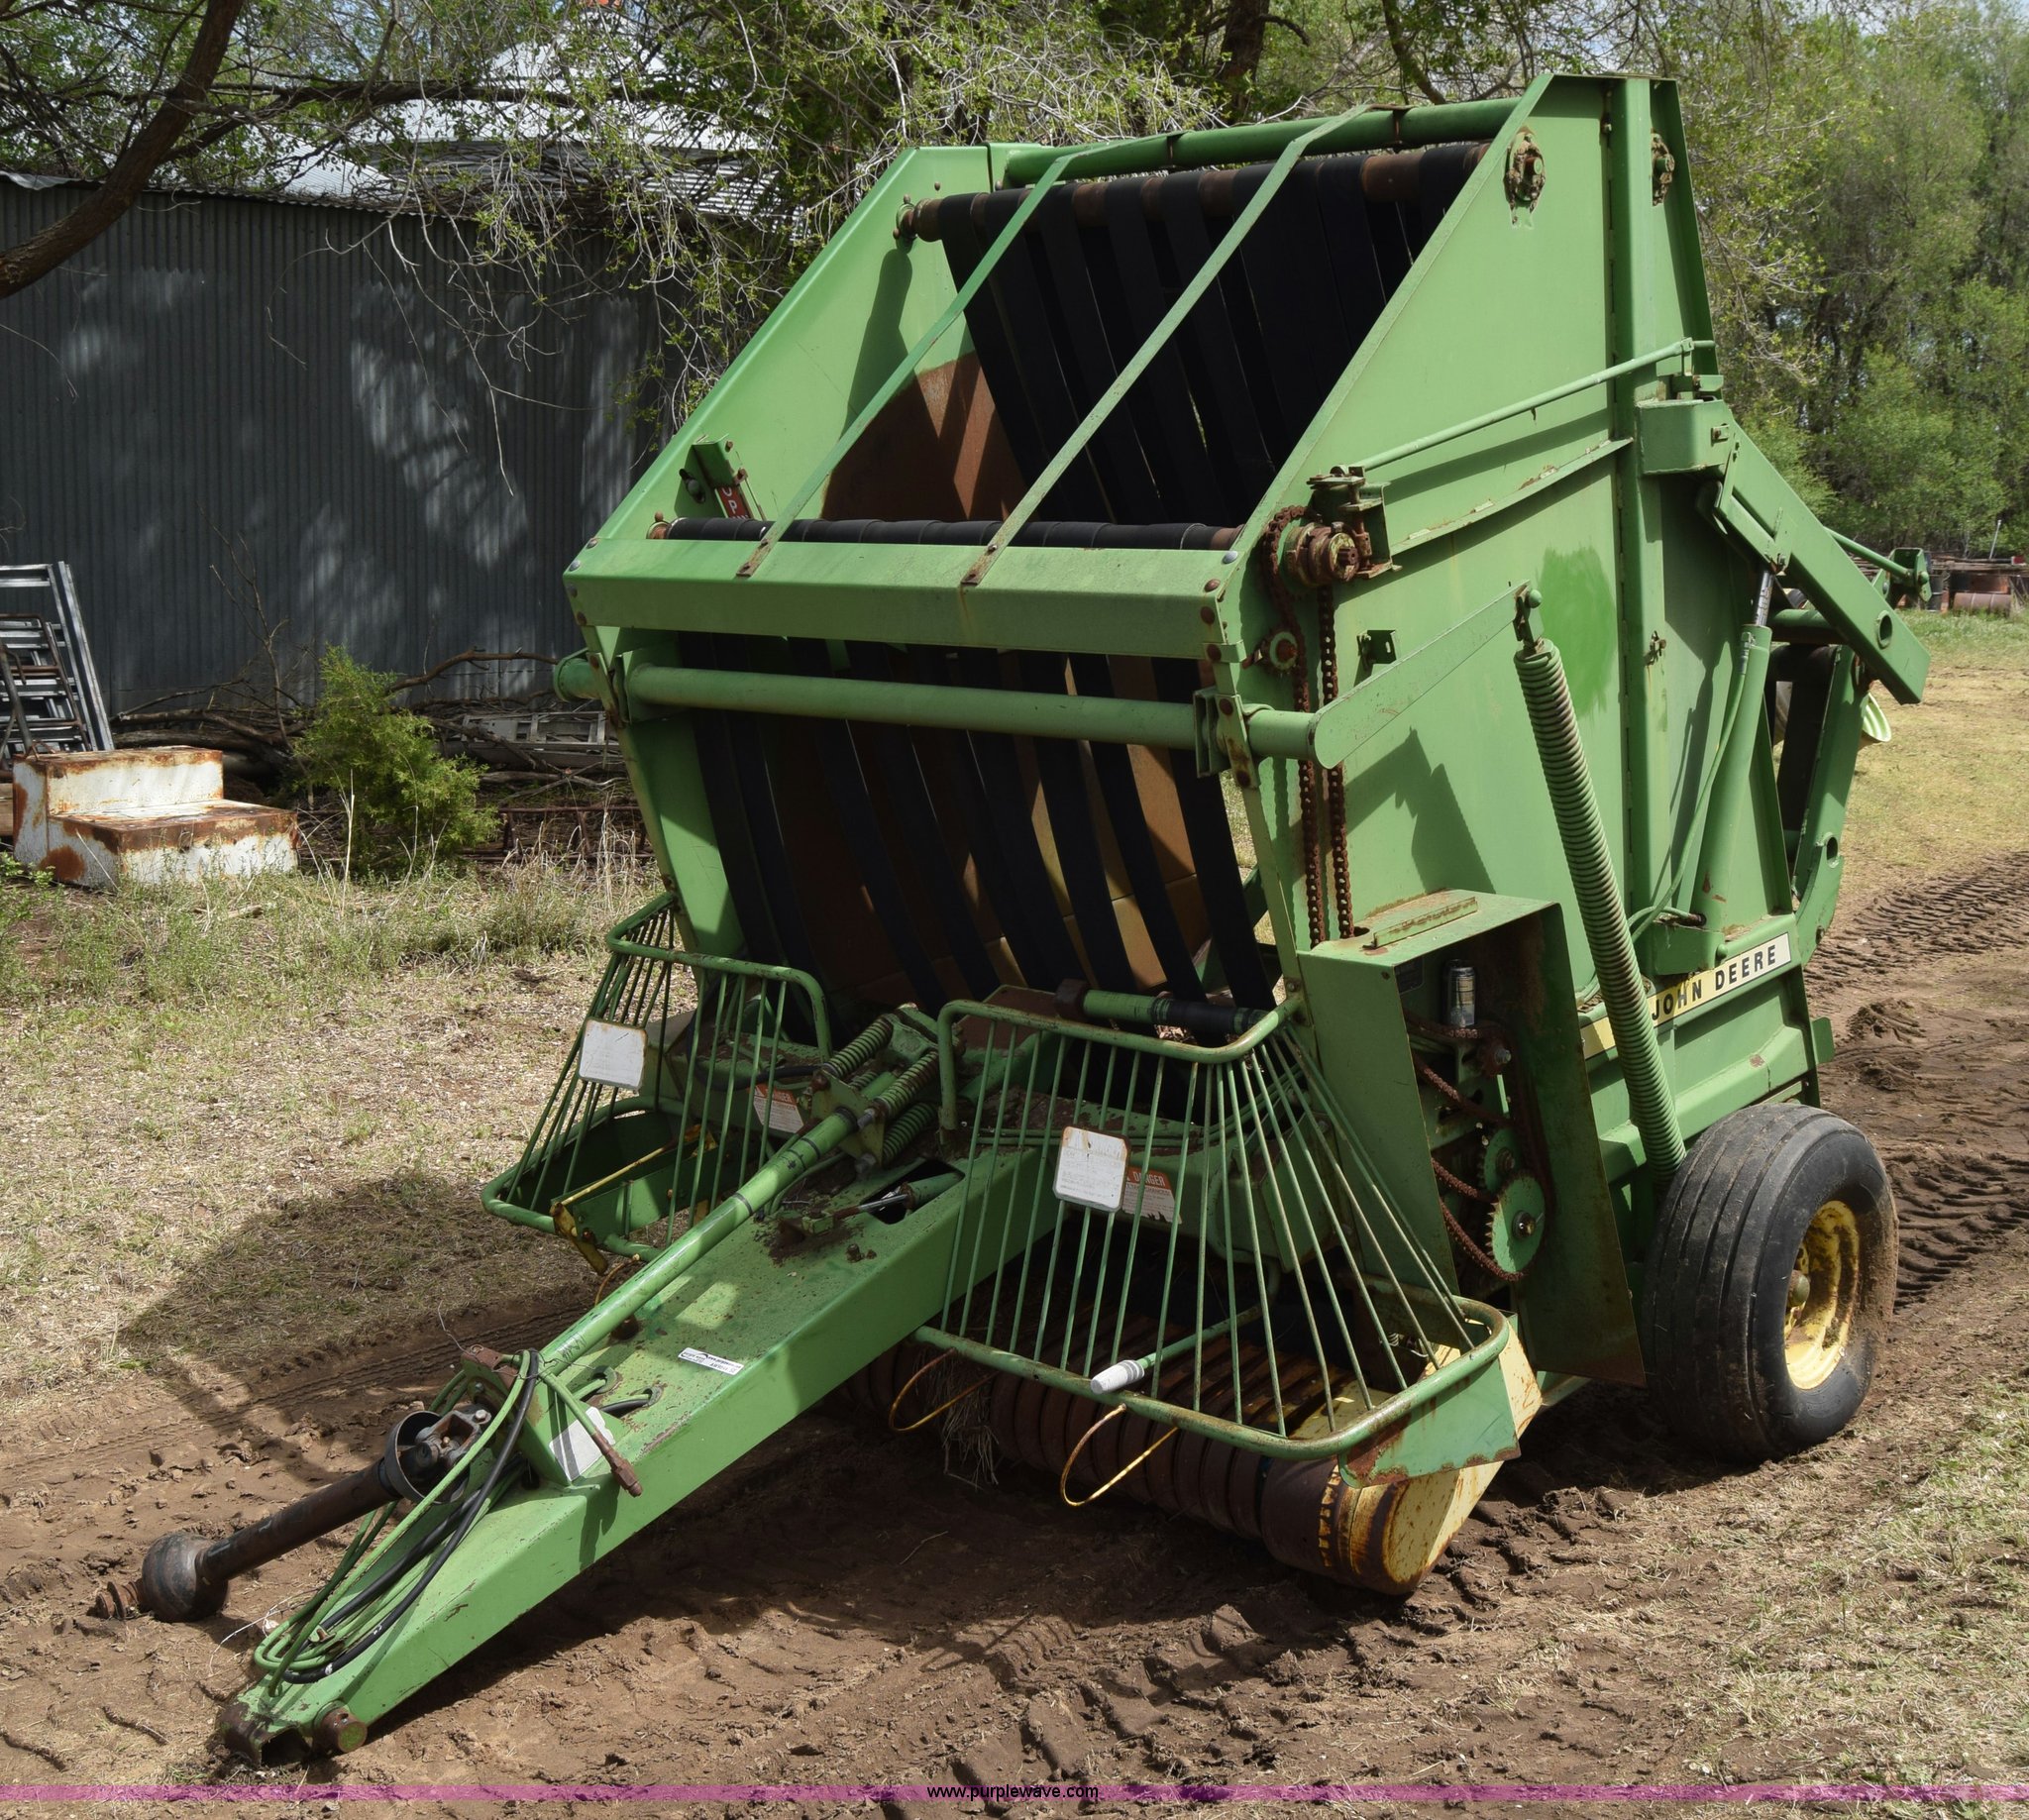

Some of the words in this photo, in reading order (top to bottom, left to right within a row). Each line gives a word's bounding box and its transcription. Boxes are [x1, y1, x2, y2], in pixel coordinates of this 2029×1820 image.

[1652, 979, 1702, 1020] JOHN
[1715, 945, 1776, 991] DEERE
[1132, 1171, 1165, 1187] DNGER
